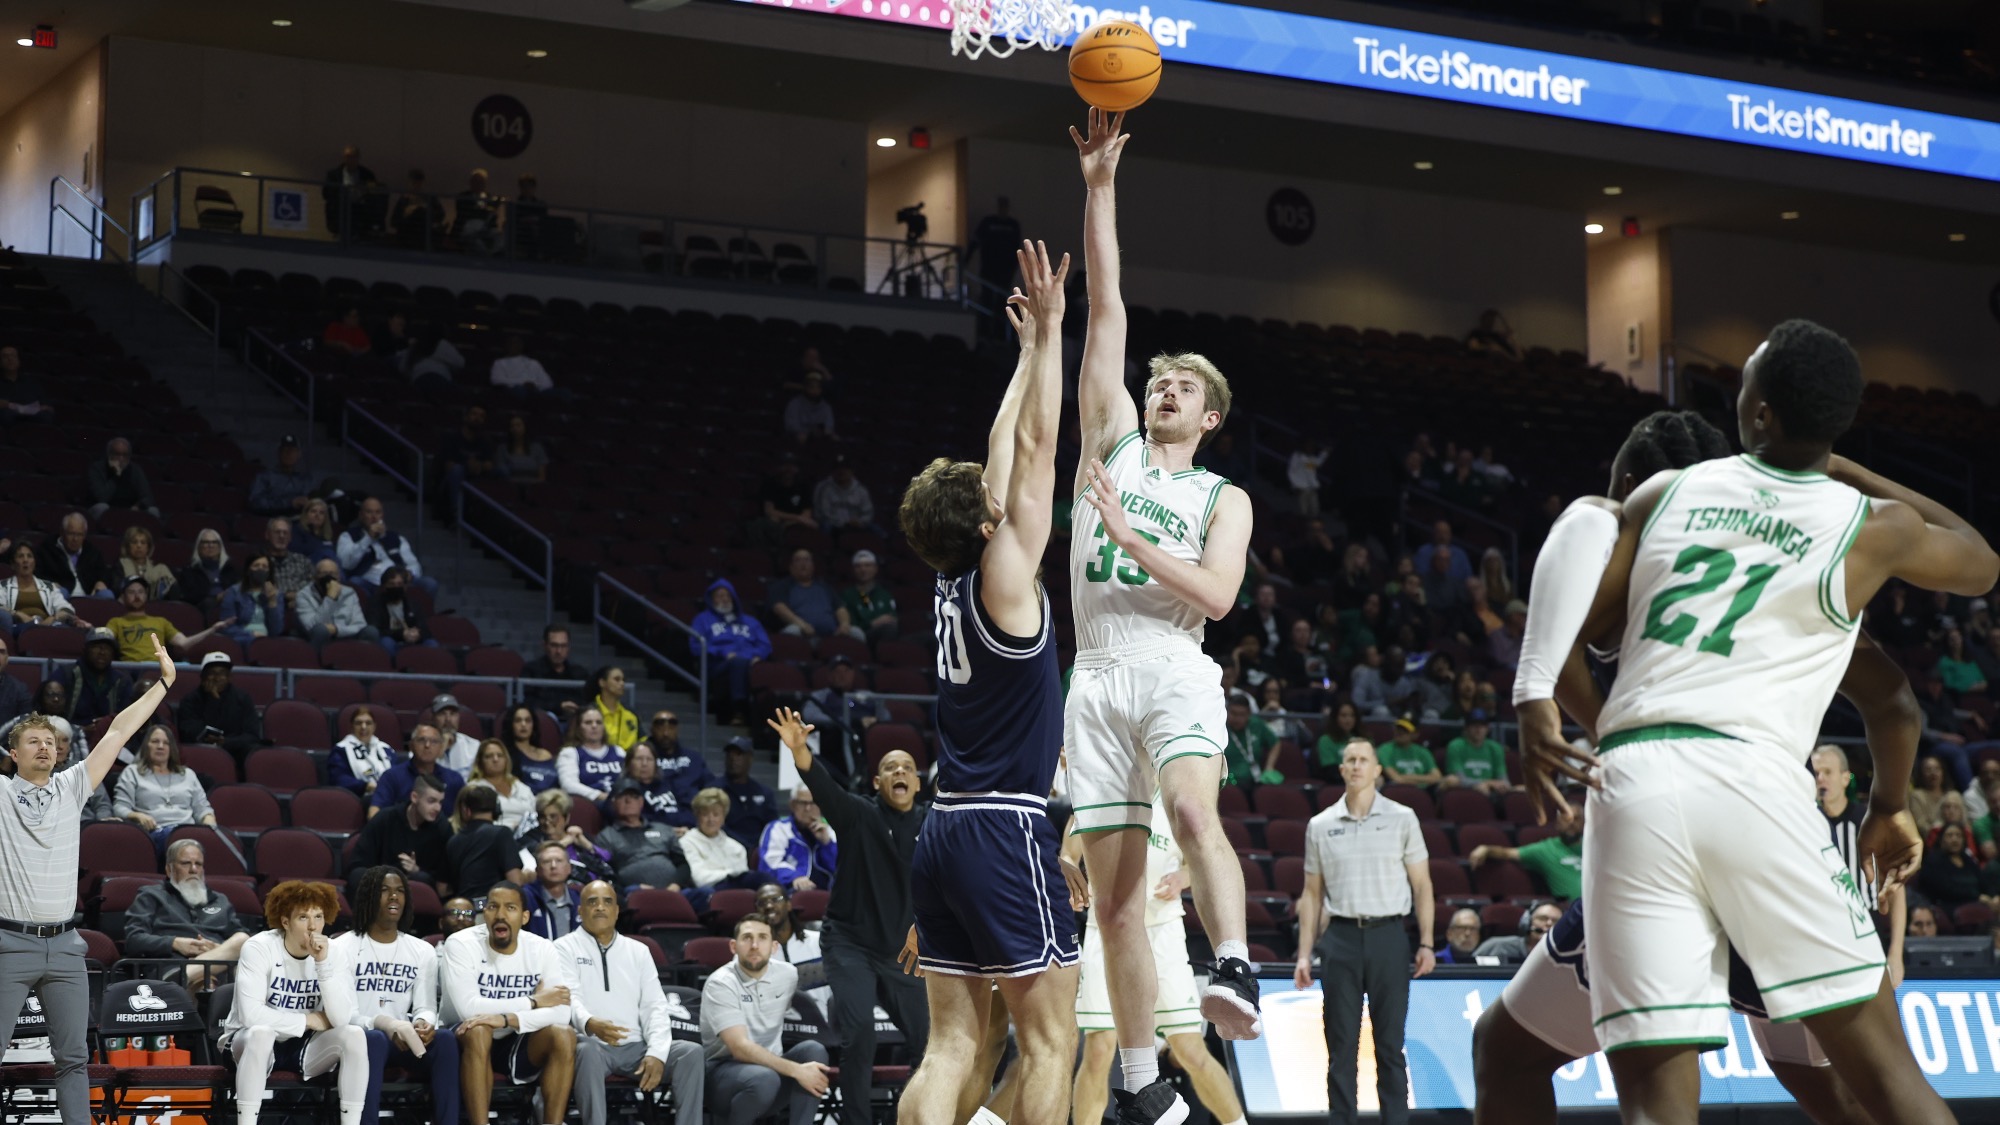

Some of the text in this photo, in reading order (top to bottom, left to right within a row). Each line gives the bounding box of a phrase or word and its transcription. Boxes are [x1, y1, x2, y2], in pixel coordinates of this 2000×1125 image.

[36, 30, 55, 47] EXIT
[1353, 37, 1587, 105] TicketSmarter
[481, 112, 525, 140] 104
[1727, 94, 1932, 158] TicketSmarter
[1274, 204, 1310, 230] 105
[1684, 507, 1813, 563] TSHIMANGA
[1086, 521, 1160, 586] 35
[1640, 544, 1781, 658] 21
[934, 594, 972, 685] 10
[586, 760, 622, 774] CBU
[355, 961, 418, 979] LANCERS
[478, 972, 541, 988] LANCERS
[356, 978, 415, 994] ENERGY
[116, 1011, 184, 1022] HERCULES TIRES
